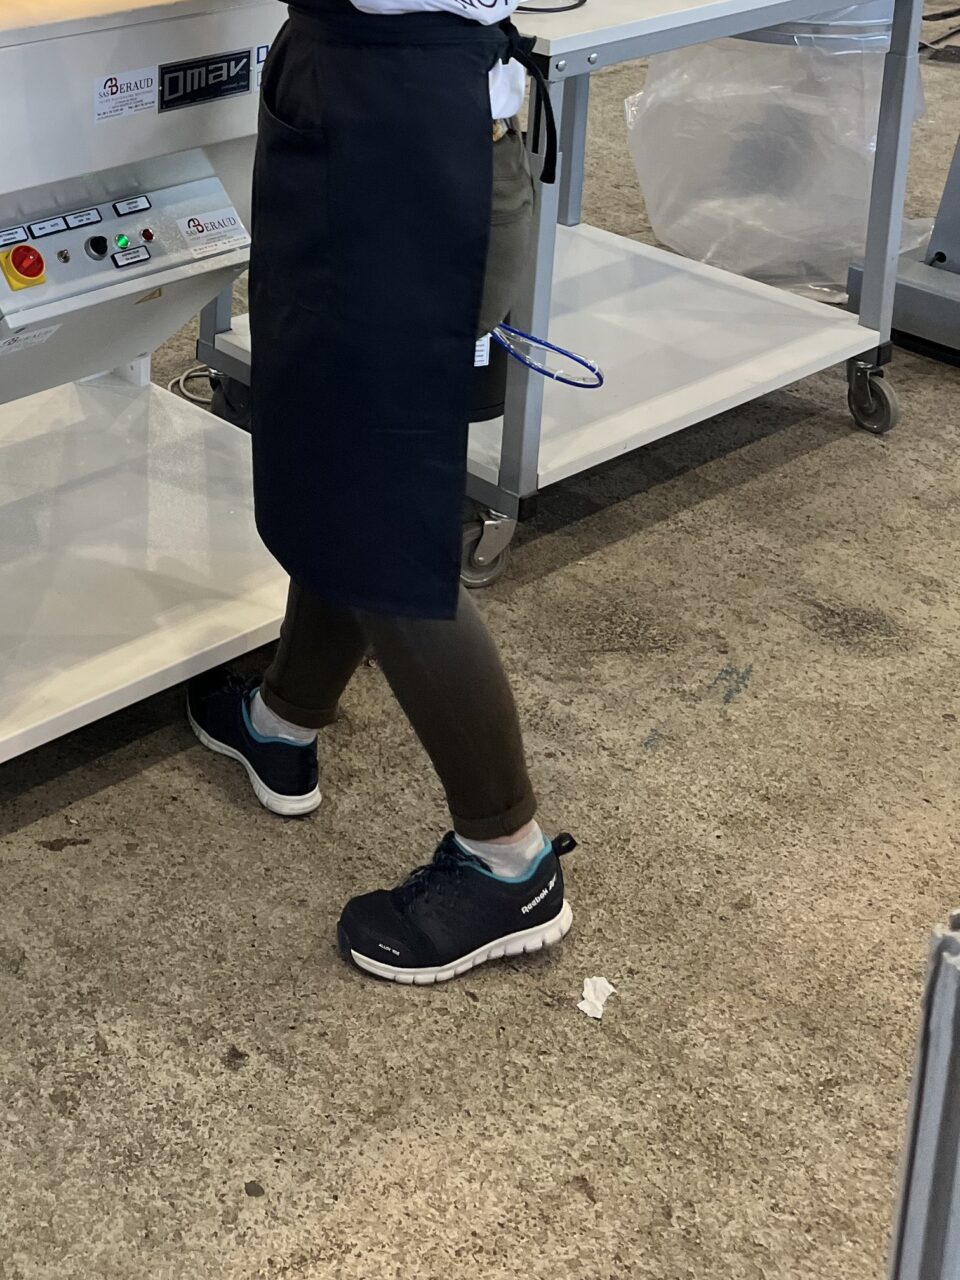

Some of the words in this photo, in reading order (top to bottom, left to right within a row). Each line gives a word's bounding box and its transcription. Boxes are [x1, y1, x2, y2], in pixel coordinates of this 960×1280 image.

[108, 77, 154, 96] BERAUD
[193, 217, 237, 234] BERAUD
[521, 888, 549, 914] Reebok
